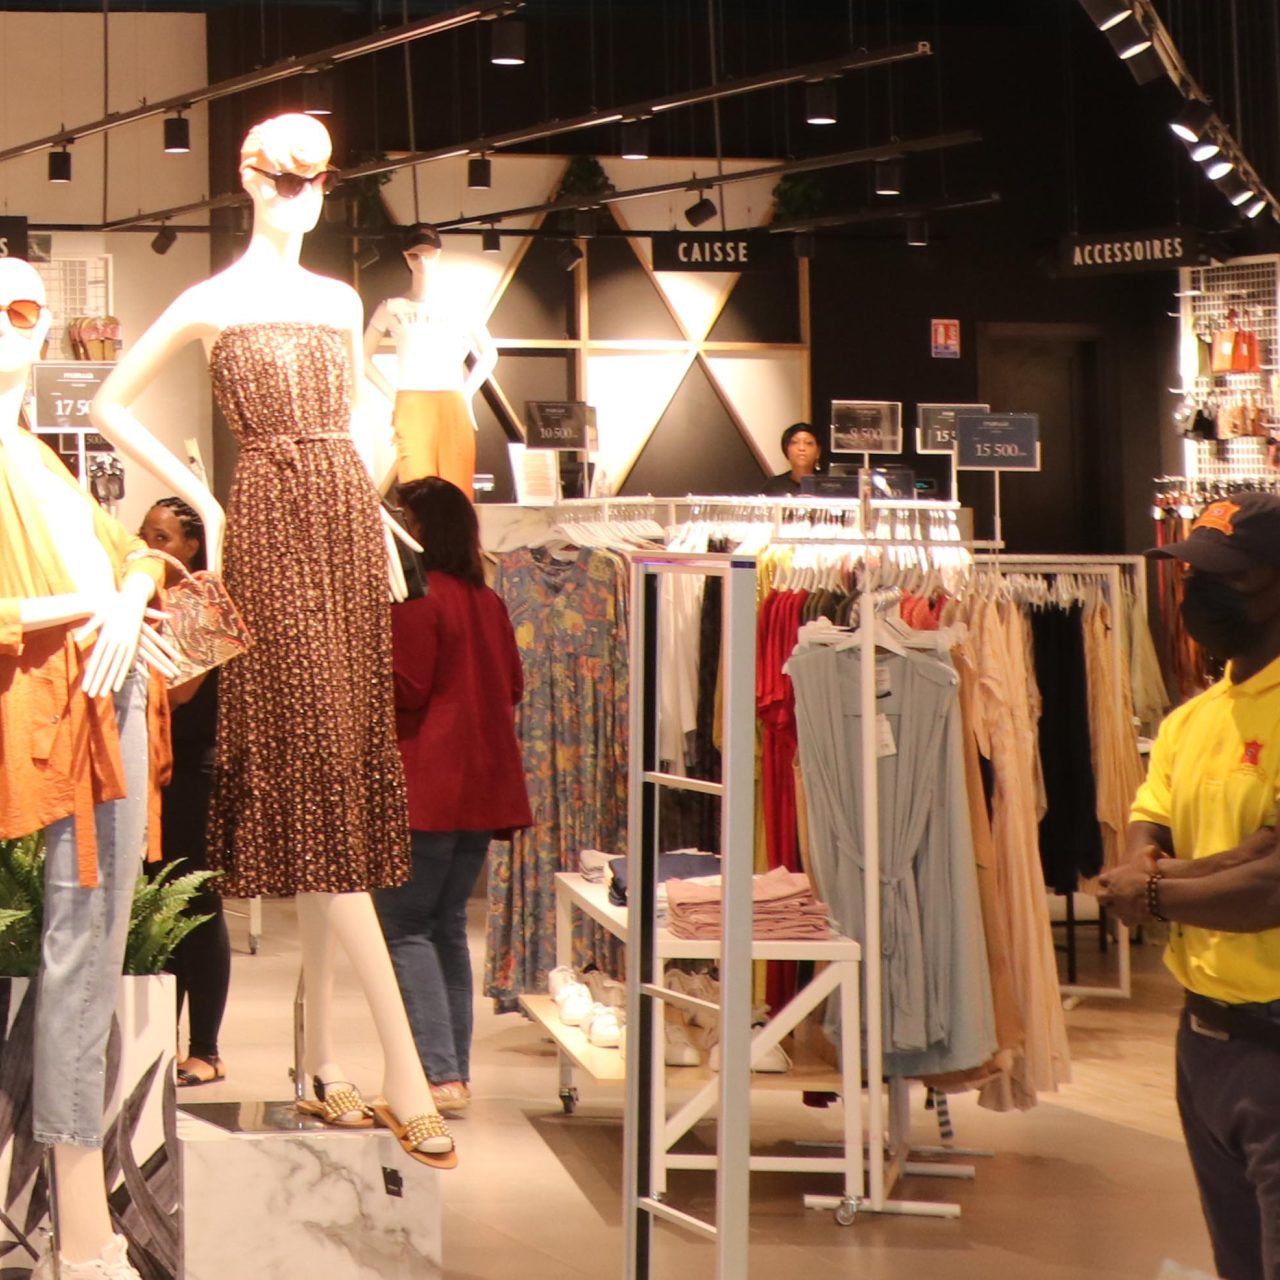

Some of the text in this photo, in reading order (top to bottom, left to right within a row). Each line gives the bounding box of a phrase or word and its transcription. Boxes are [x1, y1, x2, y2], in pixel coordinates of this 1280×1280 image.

[677, 242, 748, 262] CAISSE
[1073, 237, 1183, 266] ACCESSOIRES
[55, 400, 94, 416] 17 50
[540, 427, 553, 439] 10
[554, 427, 573, 439] 500
[936, 430, 950, 442] 15
[976, 444, 1019, 456] 15 500
